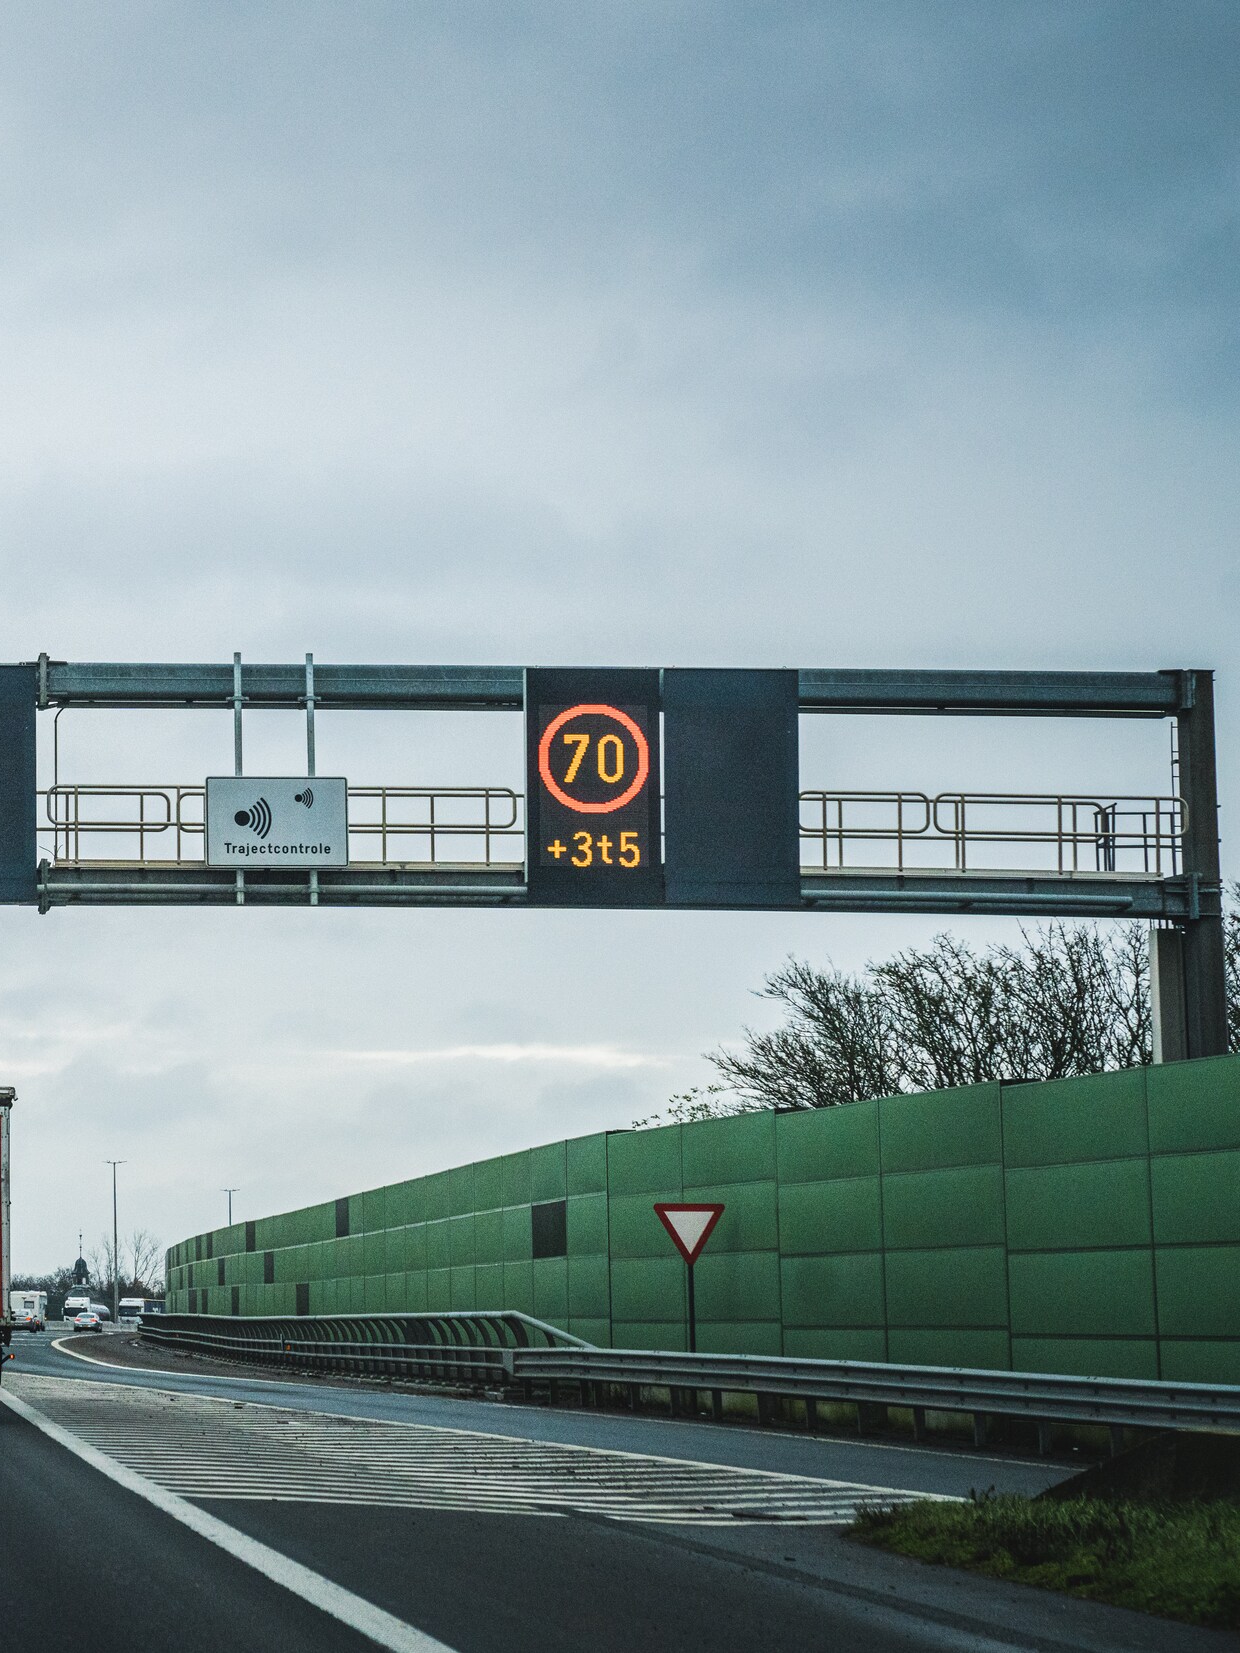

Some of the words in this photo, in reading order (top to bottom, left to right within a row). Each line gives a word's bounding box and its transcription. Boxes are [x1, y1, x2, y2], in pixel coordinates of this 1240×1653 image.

[562, 733, 626, 784] 70
[224, 842, 331, 856] Trajectcontrole
[547, 831, 641, 868] +3t5
